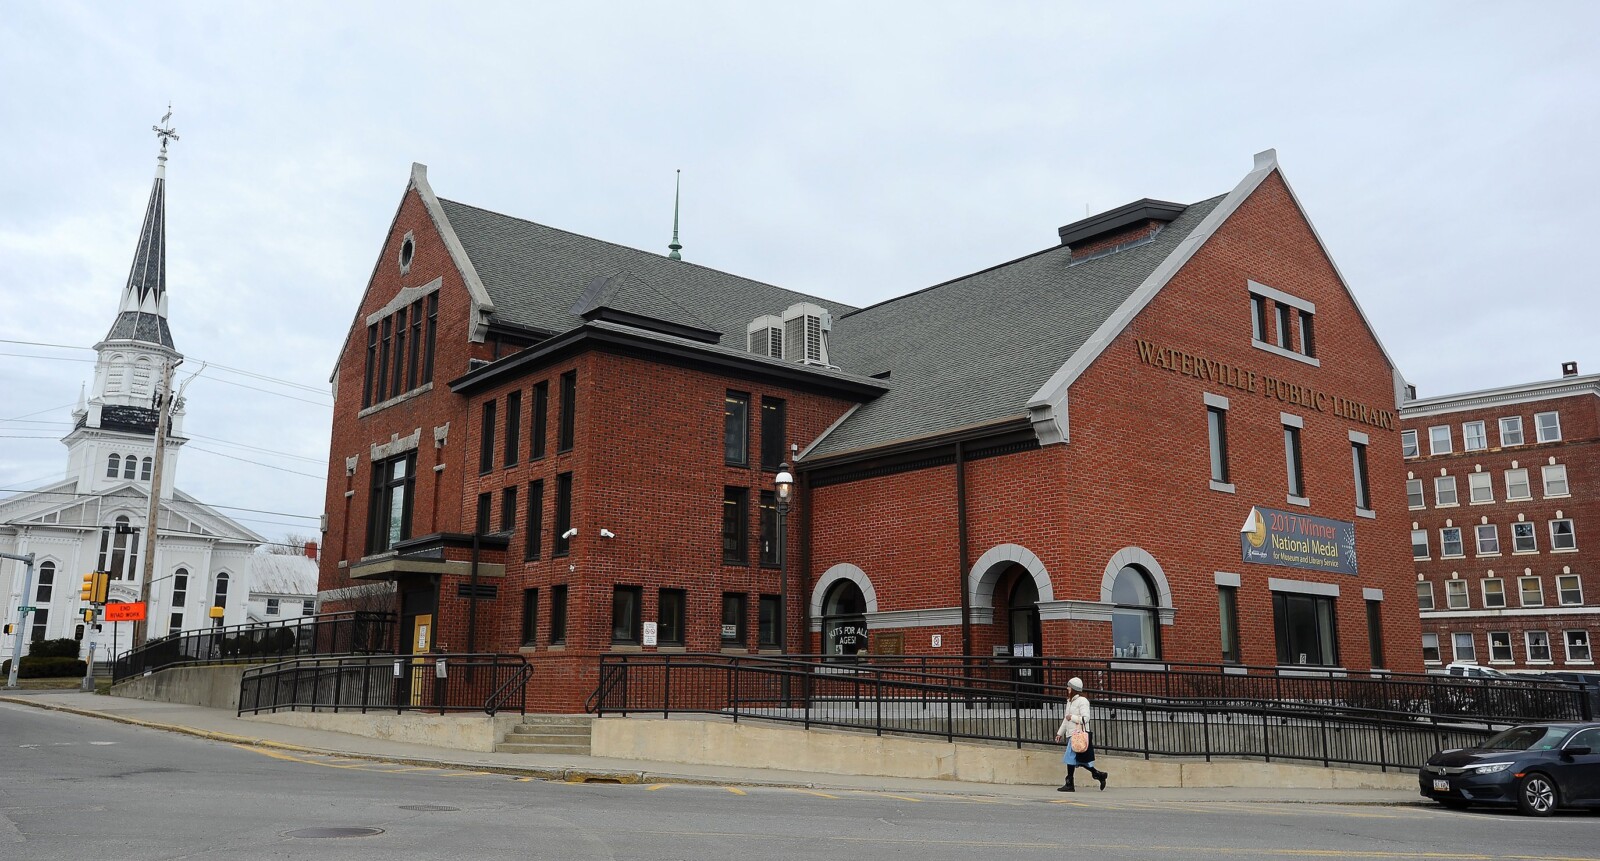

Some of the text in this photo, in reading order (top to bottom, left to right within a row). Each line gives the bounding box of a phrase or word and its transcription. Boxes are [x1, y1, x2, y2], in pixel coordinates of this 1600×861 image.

[1135, 339, 1395, 430] WATERVILLE PUBLIC LIBRARY
[1270, 513, 1336, 539] 2017 Winner
[1271, 533, 1339, 558] National Medal
[1281, 551, 1300, 563] Museum
[1300, 555, 1308, 564] and
[1309, 556, 1323, 567] Library
[1324, 558, 1339, 568] Service
[828, 626, 868, 639] KITS FOR ALL
[839, 636, 857, 645] AGES!
